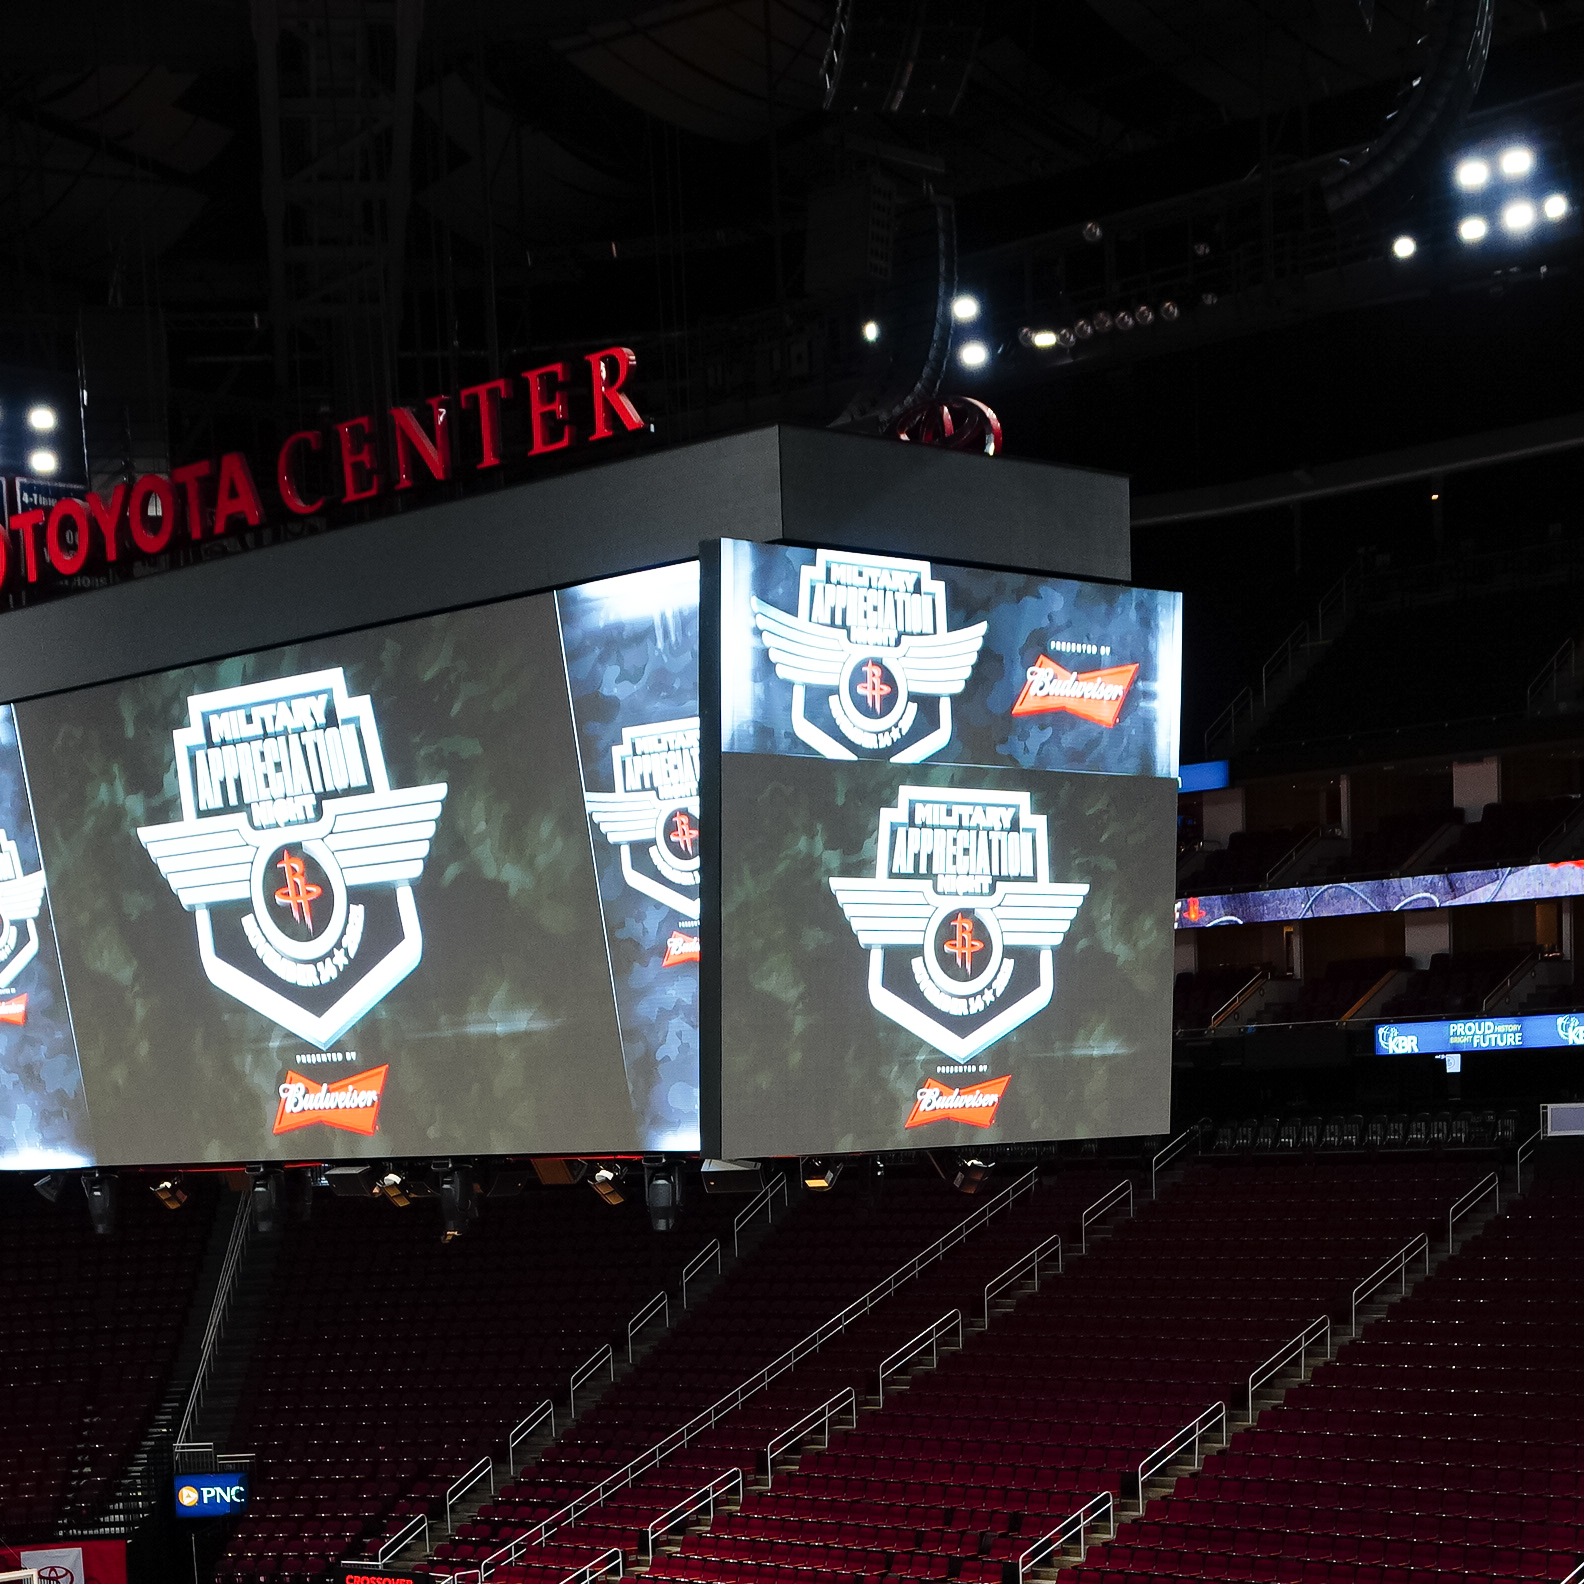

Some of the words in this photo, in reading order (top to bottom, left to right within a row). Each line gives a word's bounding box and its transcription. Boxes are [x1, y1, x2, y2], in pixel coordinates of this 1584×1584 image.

[9, 452, 263, 585] TOYOTA
[277, 346, 646, 517] CENTER
[830, 563, 919, 592] MILITARY
[810, 583, 936, 634] APPRECIATION
[1026, 666, 1124, 701] Budweiser
[209, 694, 329, 743] MILITARY
[195, 724, 367, 811] APPRECIATION
[250, 795, 317, 828] NIGHT
[915, 802, 1016, 830] MILITARY
[892, 827, 1034, 878] APPRECIATION
[1388, 1035, 1419, 1054] KBR
[1449, 1022, 1494, 1037] PROUD
[1494, 1024, 1522, 1033] HISTORY
[1473, 1033, 1523, 1047] FUTURE
[296, 1052, 343, 1064] PRESENTED
[345, 1051, 356, 1061] BY
[279, 1082, 378, 1113] Budweiser
[917, 1087, 999, 1112] Budweiser
[201, 1485, 244, 1504] PNC
